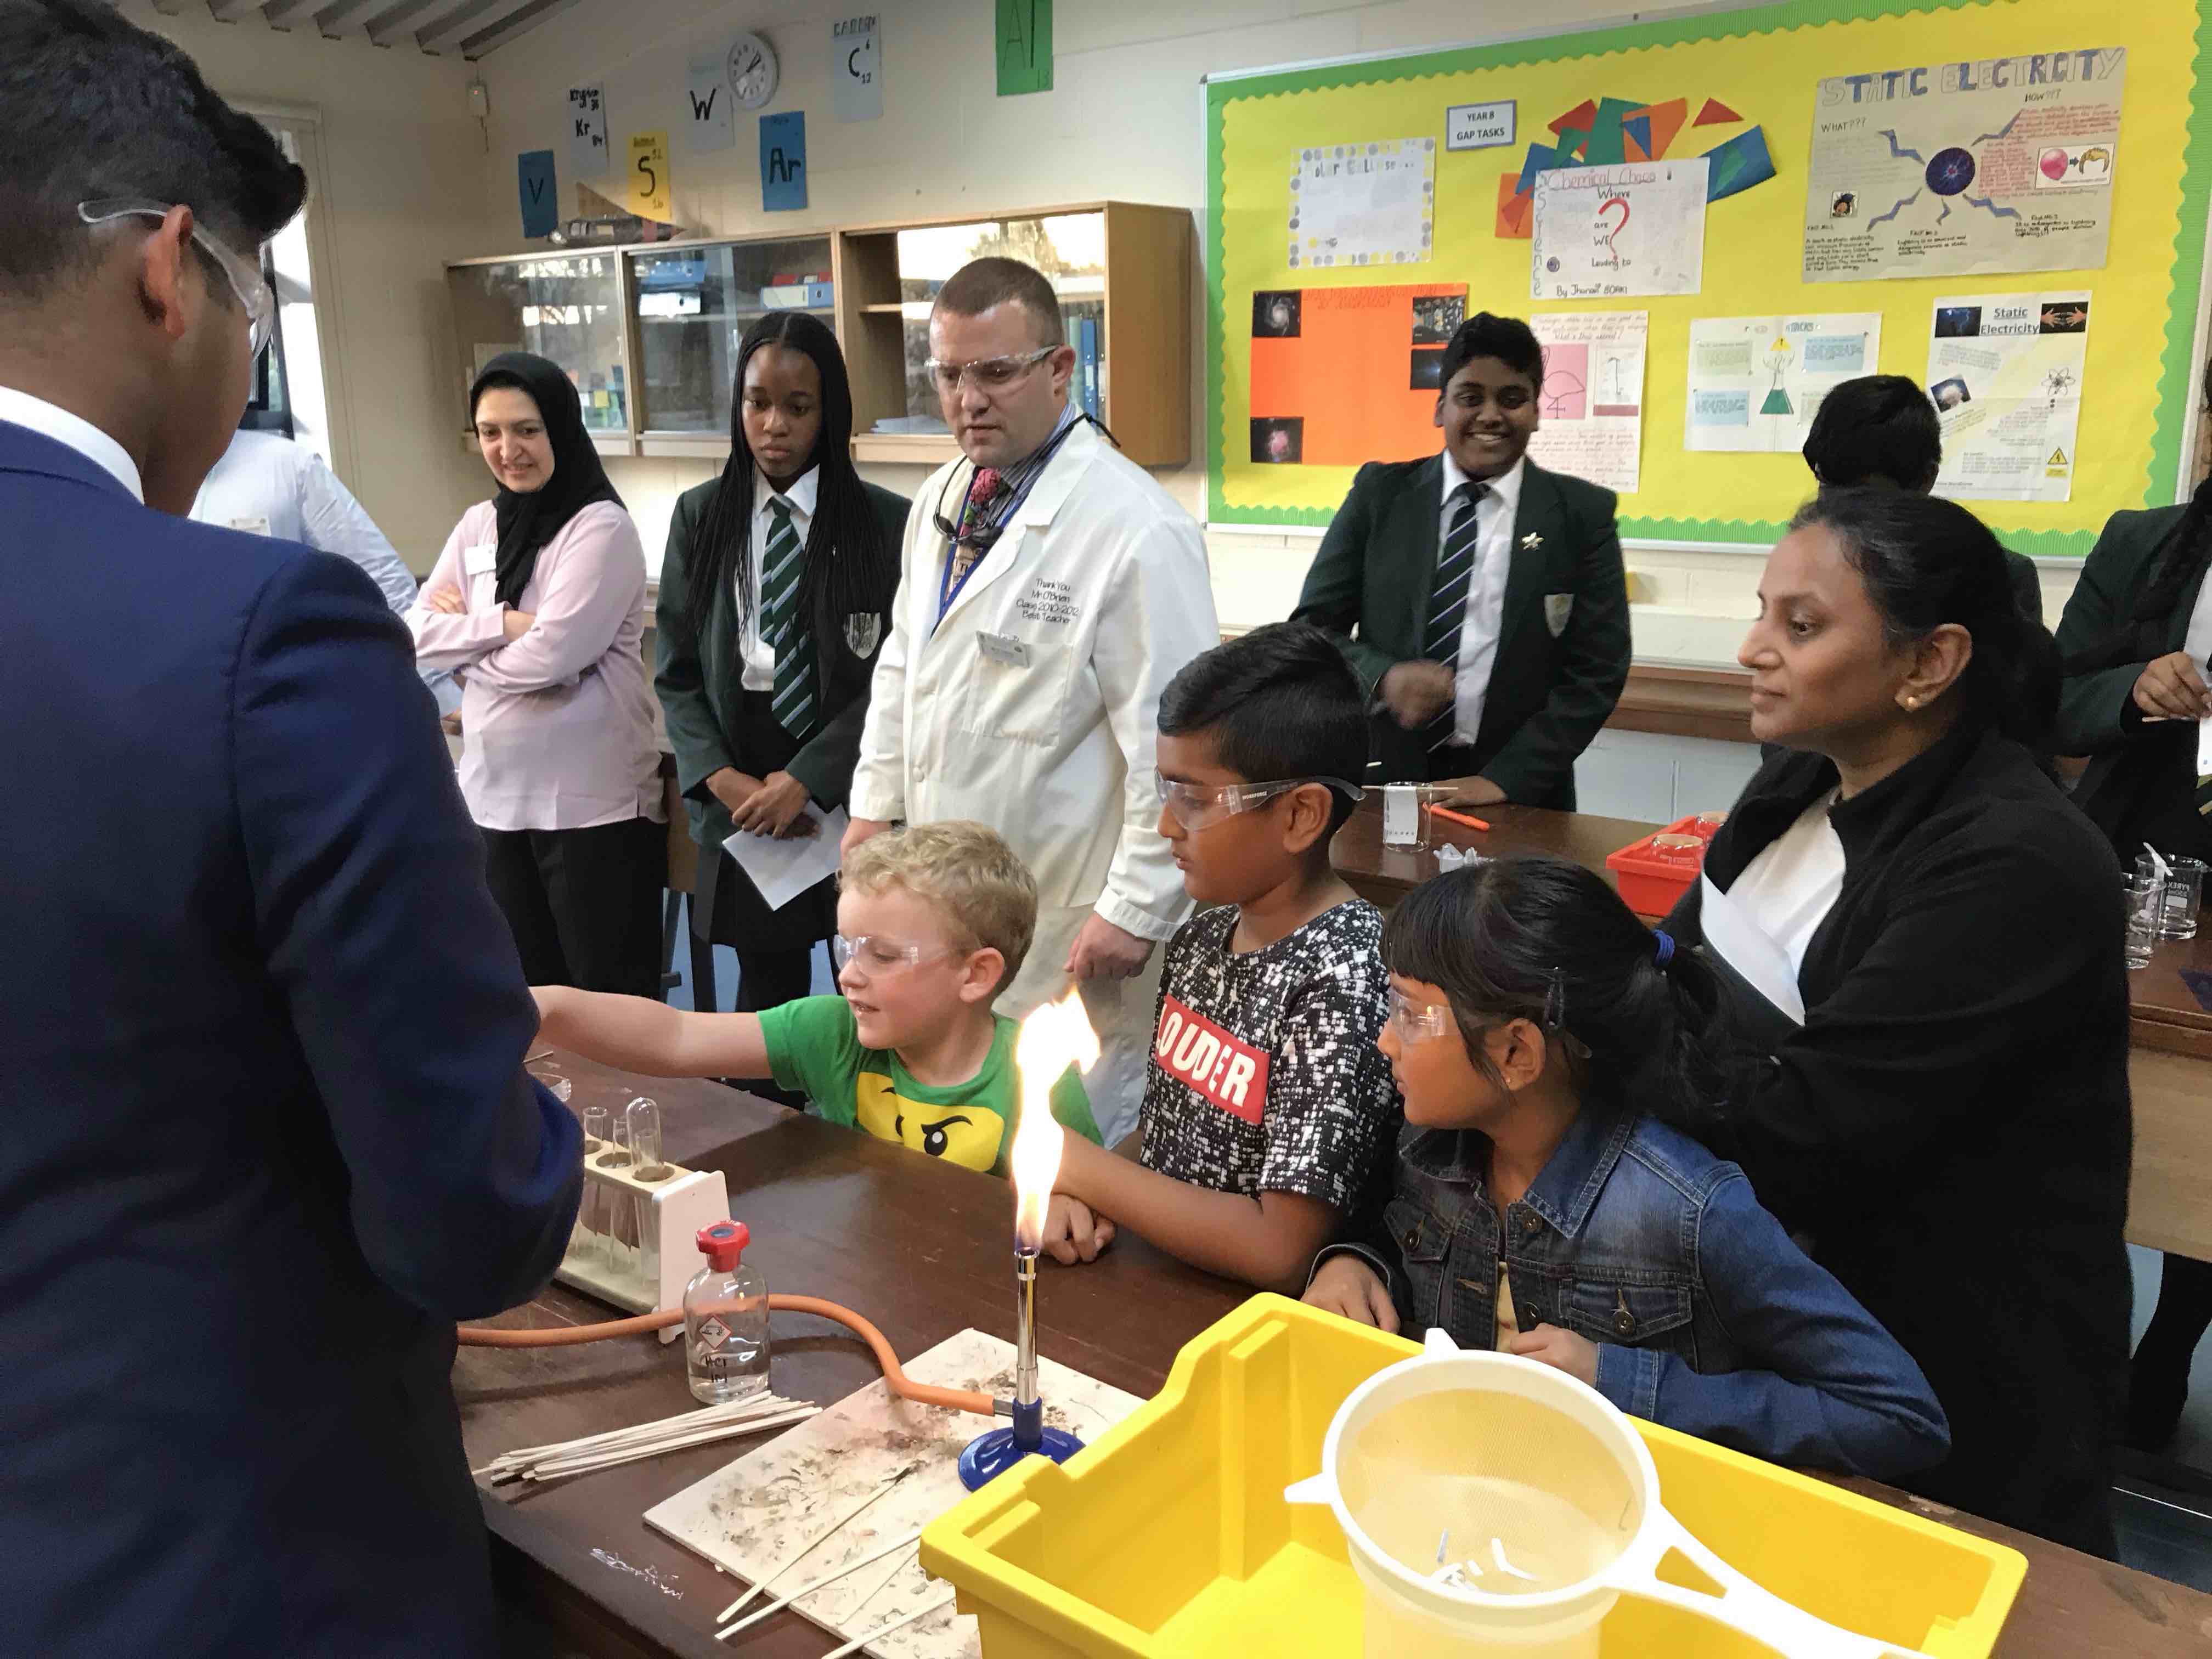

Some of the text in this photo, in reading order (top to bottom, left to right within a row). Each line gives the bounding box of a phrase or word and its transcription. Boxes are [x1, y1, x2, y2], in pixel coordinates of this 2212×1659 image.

[849, 48, 860, 77] C
[1821, 46, 2125, 106] STATIC ELECTRICITY
[690, 88, 716, 120] W
[1467, 112, 1487, 123] YEAR
[576, 119, 590, 137] Kr
[1457, 127, 1505, 140] GAP TASKS
[770, 147, 801, 184] Ar
[638, 155, 655, 197] S
[528, 178, 544, 205] V
[1622, 258, 1632, 267] to
[1556, 285, 1567, 298] By
[1994, 307, 2028, 318] Static
[1980, 323, 2039, 335] Electricity
[1036, 578, 1070, 591] Thank You
[1031, 589, 1041, 599] Mr
[1016, 598, 1037, 610] Class
[1022, 610, 1070, 623] Best Teacher
